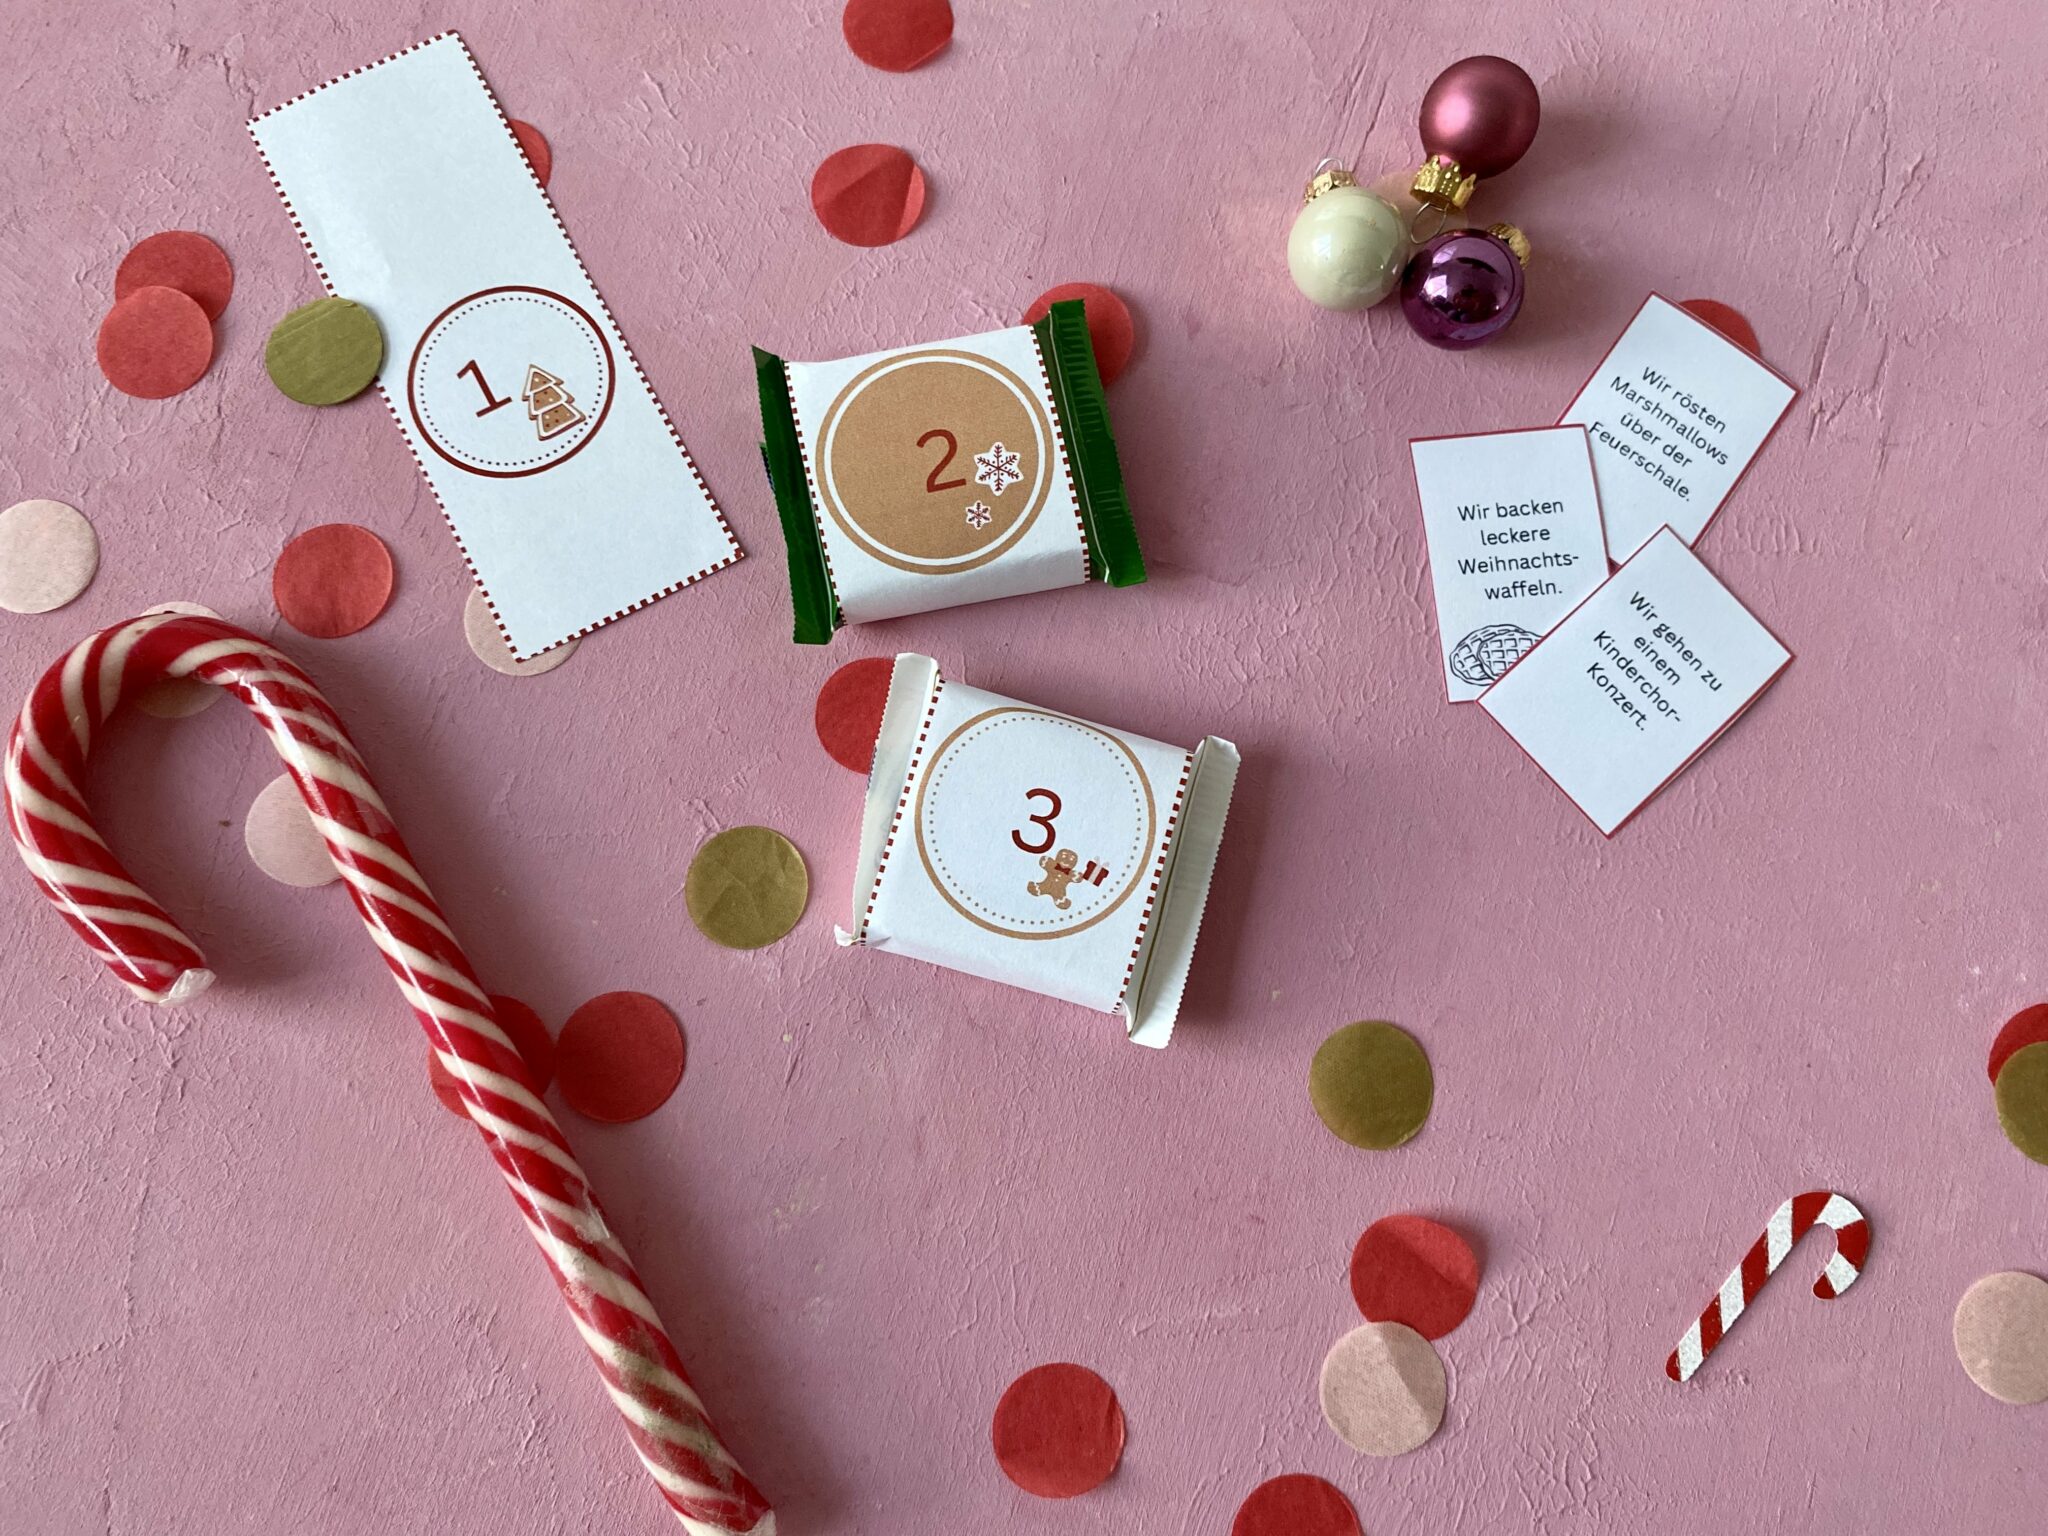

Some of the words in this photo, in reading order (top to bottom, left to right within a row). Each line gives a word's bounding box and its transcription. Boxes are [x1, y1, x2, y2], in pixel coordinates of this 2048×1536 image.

[456, 358, 513, 418] 1
[1610, 376, 1729, 465] Marshmallows
[1642, 366, 1672, 393] Wir
[1672, 391, 1727, 434] rösten
[915, 428, 967, 494] 2
[1588, 421, 1690, 502] Feuerschale.
[1620, 412, 1662, 445] über
[1662, 444, 1693, 468] der
[1457, 504, 1490, 521] Wir
[1495, 499, 1564, 518] backen
[1480, 527, 1551, 546] leckere
[1457, 552, 1579, 575] Weihnachts-
[1484, 579, 1563, 600] waffeln.
[1629, 591, 1658, 621] Wir
[1652, 622, 1703, 672] gehen
[1701, 670, 1723, 691] zu
[1633, 636, 1681, 686] einem
[1586, 662, 1647, 731] Konzert.
[1593, 630, 1681, 723] Kinderchor-
[1011, 787, 1062, 855] 3
